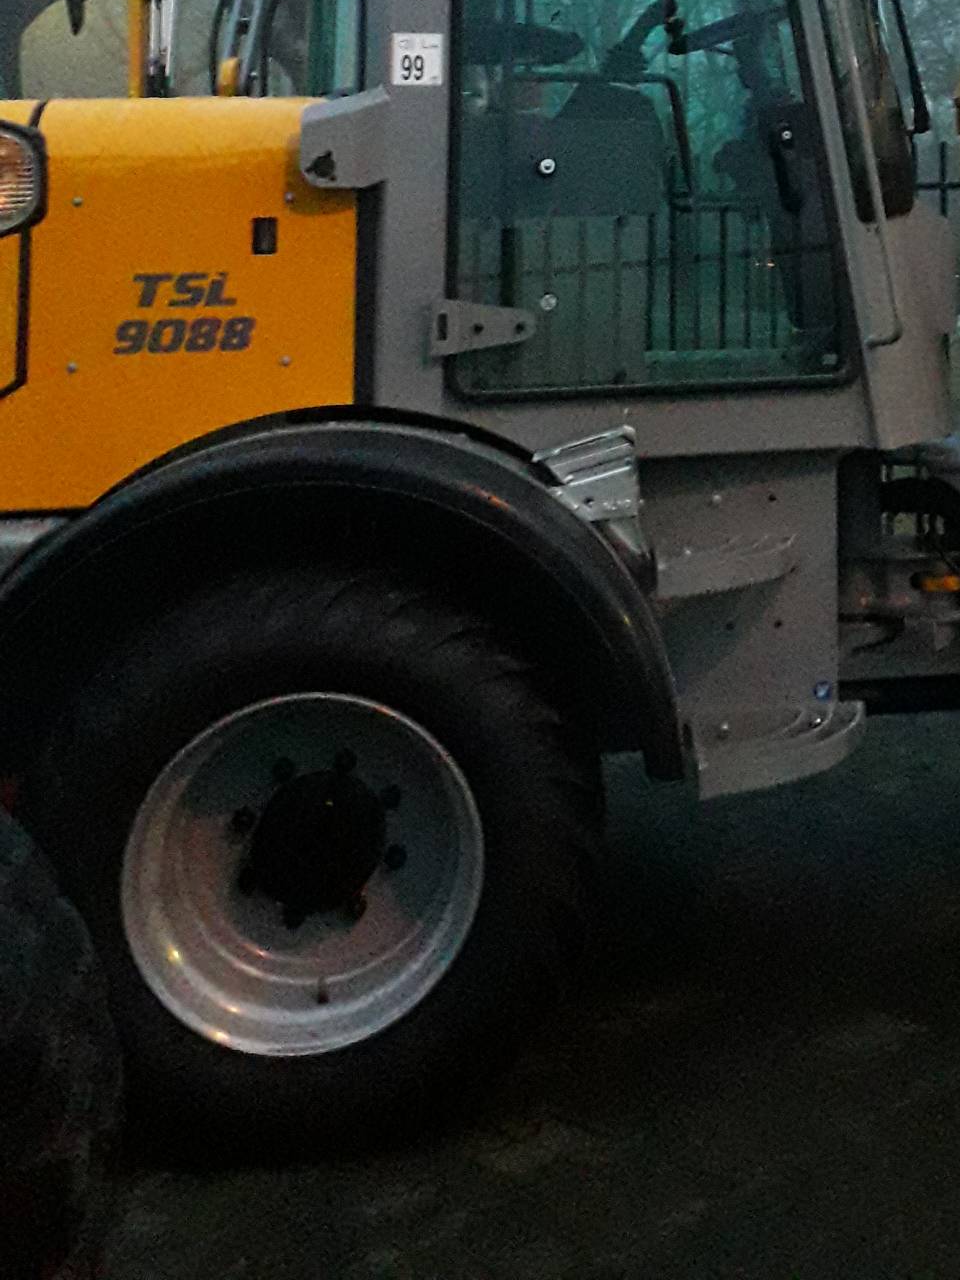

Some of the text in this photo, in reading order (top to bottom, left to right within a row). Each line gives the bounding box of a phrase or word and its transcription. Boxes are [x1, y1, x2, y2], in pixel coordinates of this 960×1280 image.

[401, 54, 424, 81] 99
[133, 271, 238, 308] TSL
[112, 315, 257, 355] 9088
